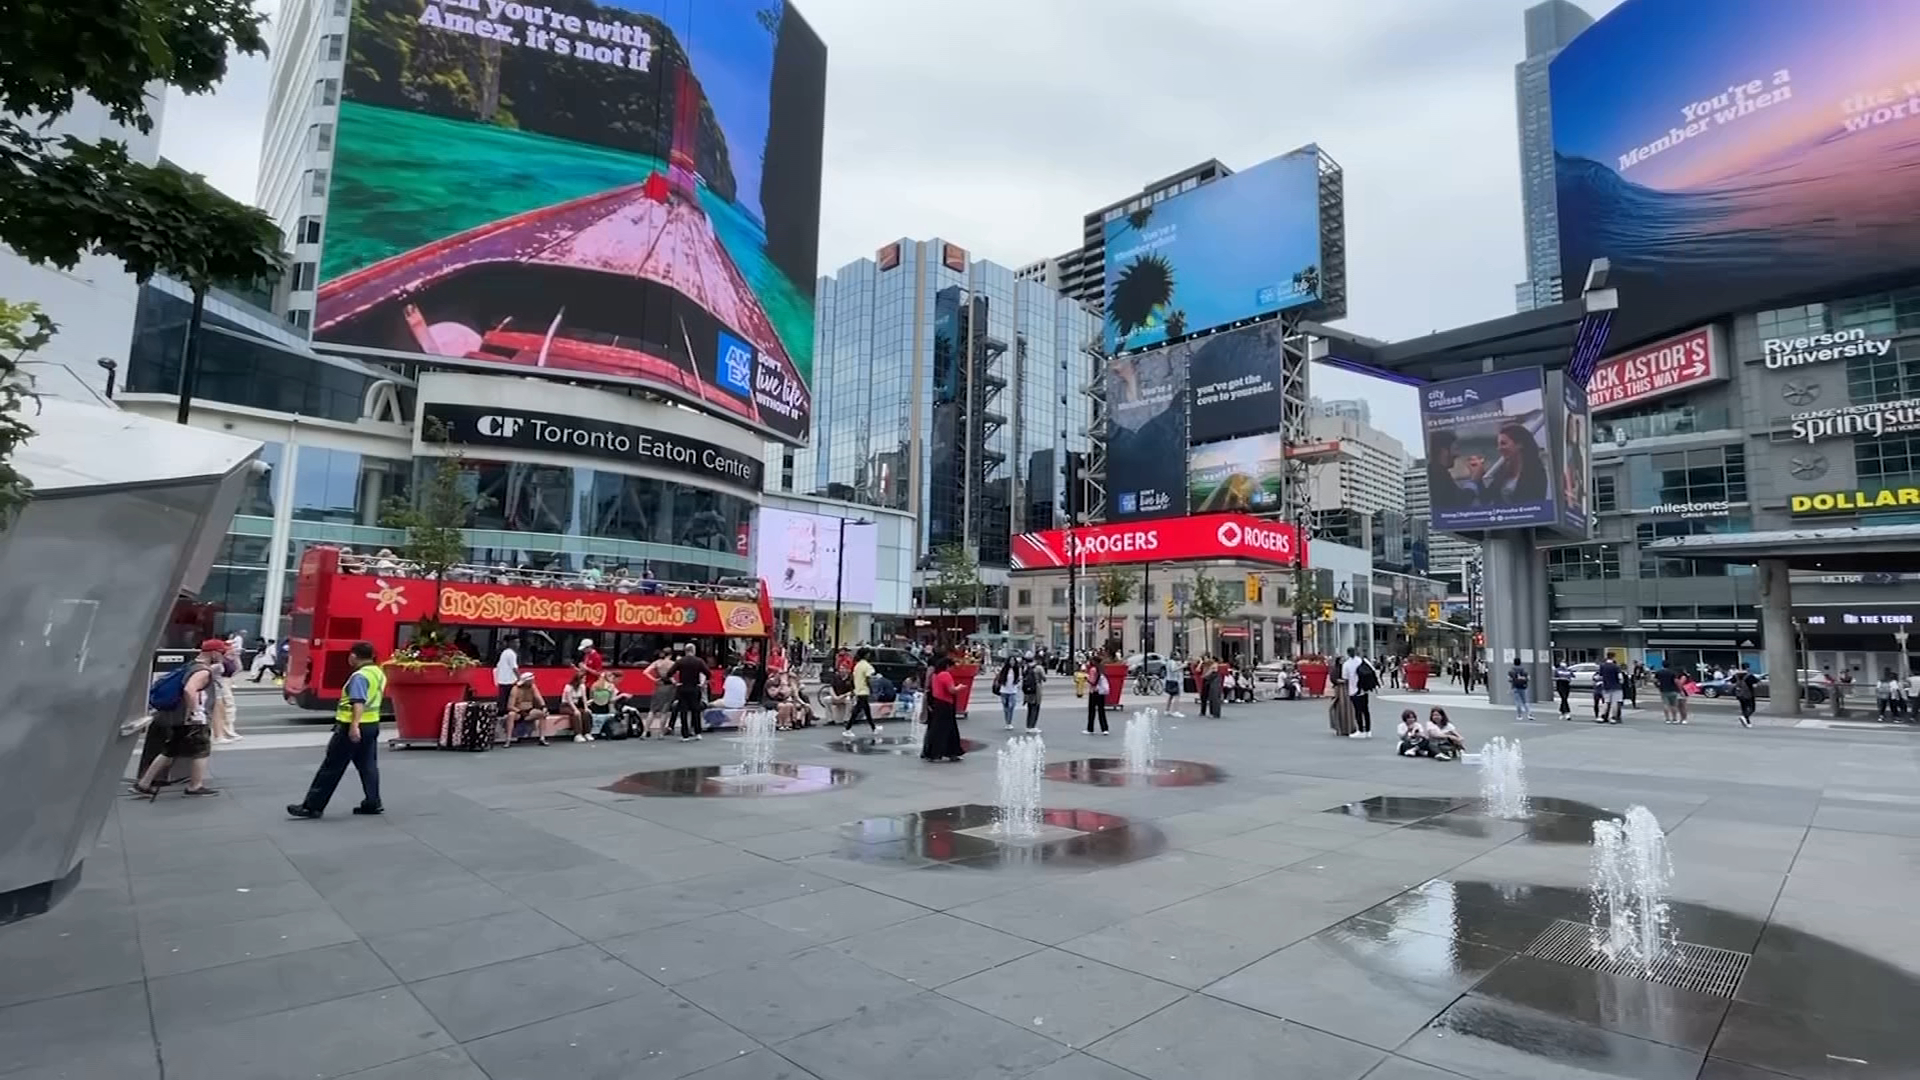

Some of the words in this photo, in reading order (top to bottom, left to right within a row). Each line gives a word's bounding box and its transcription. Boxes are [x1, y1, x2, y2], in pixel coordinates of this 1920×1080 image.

[418, 4, 521, 46] Amex,
[525, 25, 570, 56] it's
[575, 41, 625, 68] not
[628, 52, 651, 72] if
[487, 0, 581, 33] you're
[585, 18, 651, 49] with
[1680, 79, 1763, 123] You're
[1772, 68, 1791, 86] a
[1617, 117, 1710, 172] Member
[1714, 85, 1793, 125] when
[1764, 328, 1865, 355] Ryerson
[1765, 339, 1891, 369] University
[1586, 364, 1619, 393] ACK
[1624, 338, 1706, 382] ASTOR'S
[1428, 390, 1445, 400] city
[1613, 385, 1625, 400] IS
[1625, 378, 1652, 397] THIS
[1653, 368, 1680, 388] WAY
[1429, 396, 1463, 409] cruises
[1791, 407, 1837, 421] LOUNGE
[476, 415, 524, 438] CF
[531, 418, 630, 452] Toronto
[638, 435, 697, 465] Eaton
[702, 449, 751, 480] Centre
[1650, 500, 1729, 514] milestones
[1085, 531, 1158, 554] ROGERS
[1244, 527, 1290, 553] ROGERS
[439, 588, 606, 626] CitySightseeing
[614, 599, 685, 626] Toronto
[1860, 615, 1879, 624] THE
[1881, 614, 1913, 624] TENOR
